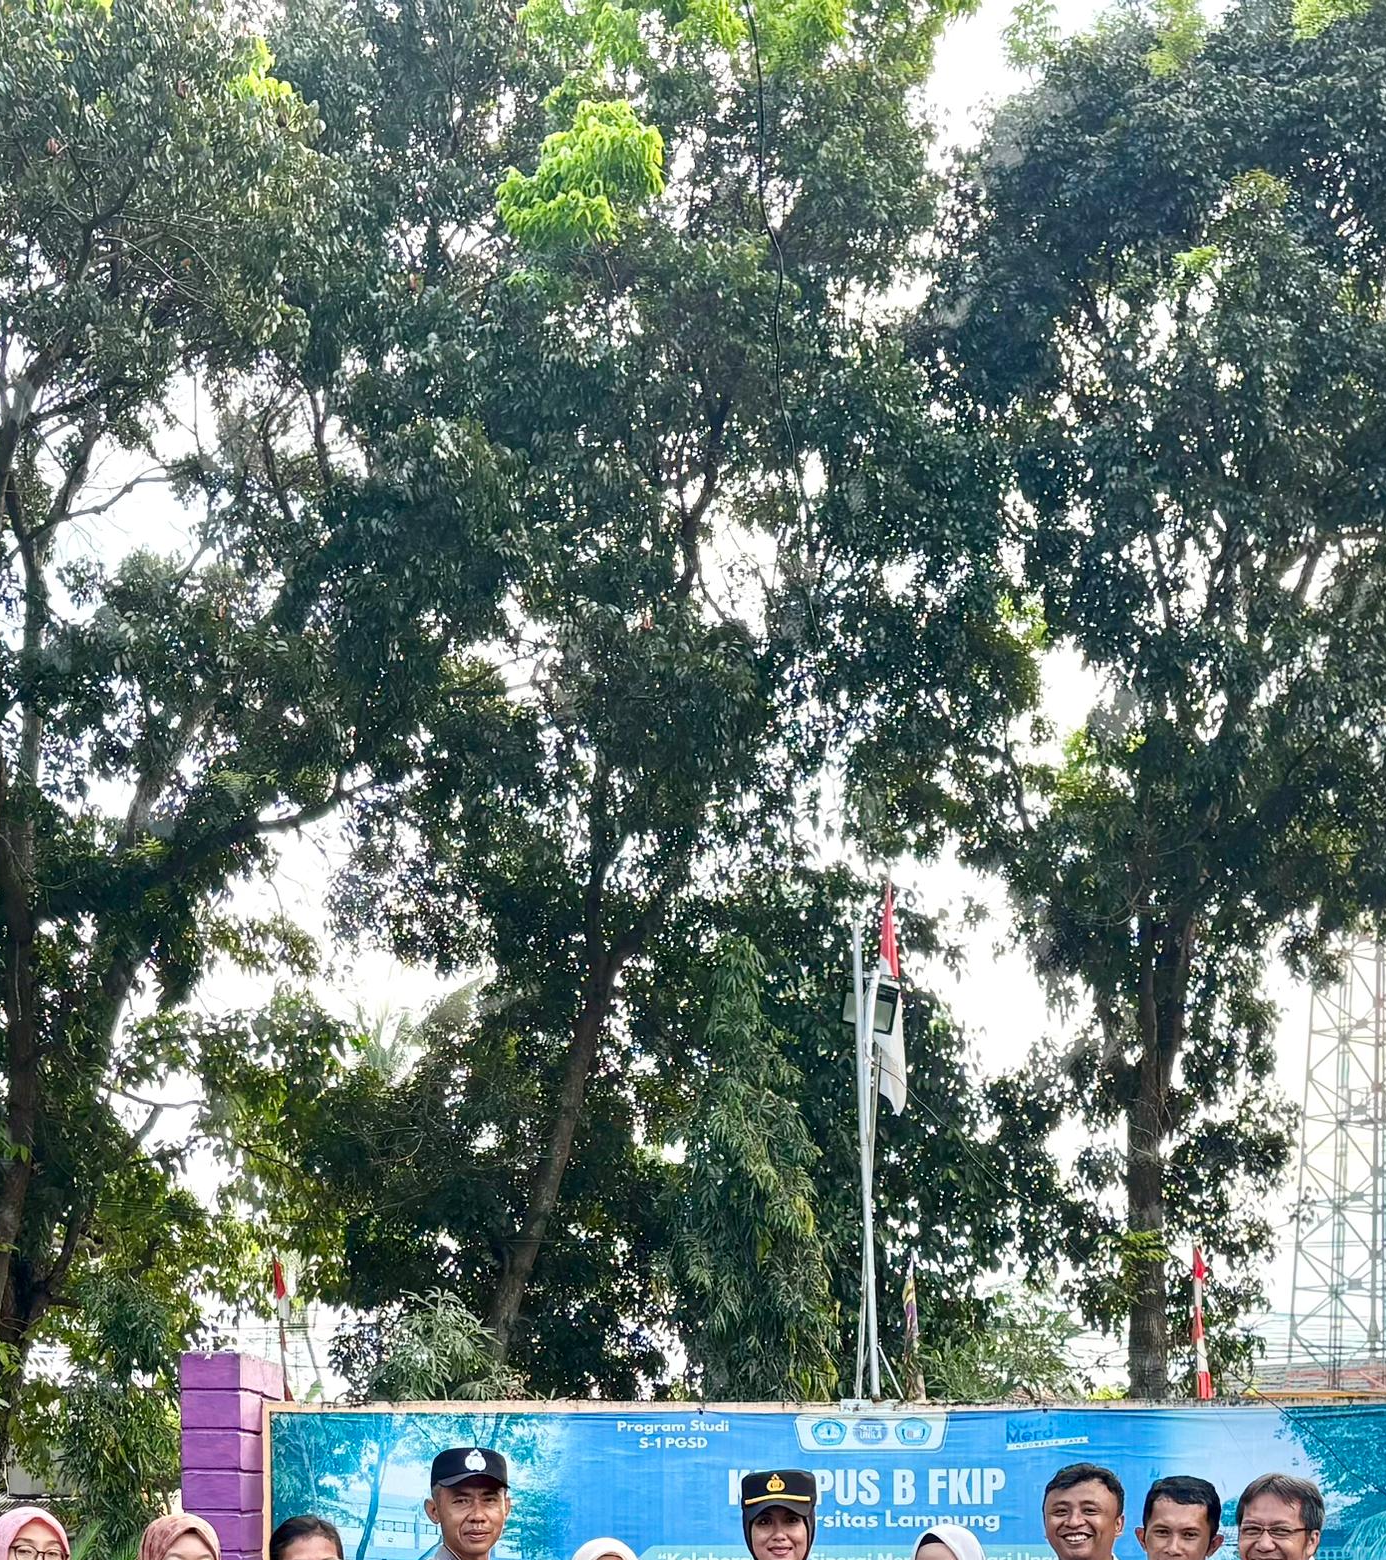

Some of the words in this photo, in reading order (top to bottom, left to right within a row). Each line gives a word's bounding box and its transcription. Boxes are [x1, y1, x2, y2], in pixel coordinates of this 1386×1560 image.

[617, 1420, 686, 1434] Program
[690, 1419, 730, 1433] Studi
[638, 1438, 663, 1449] S-1
[665, 1437, 708, 1449] PGSD
[728, 1468, 881, 1505] KPUS
[893, 1469, 915, 1505] B
[929, 1469, 1006, 1504] FKIP
[816, 1510, 879, 1528] rsitas
[885, 1509, 1001, 1532] Lampung
